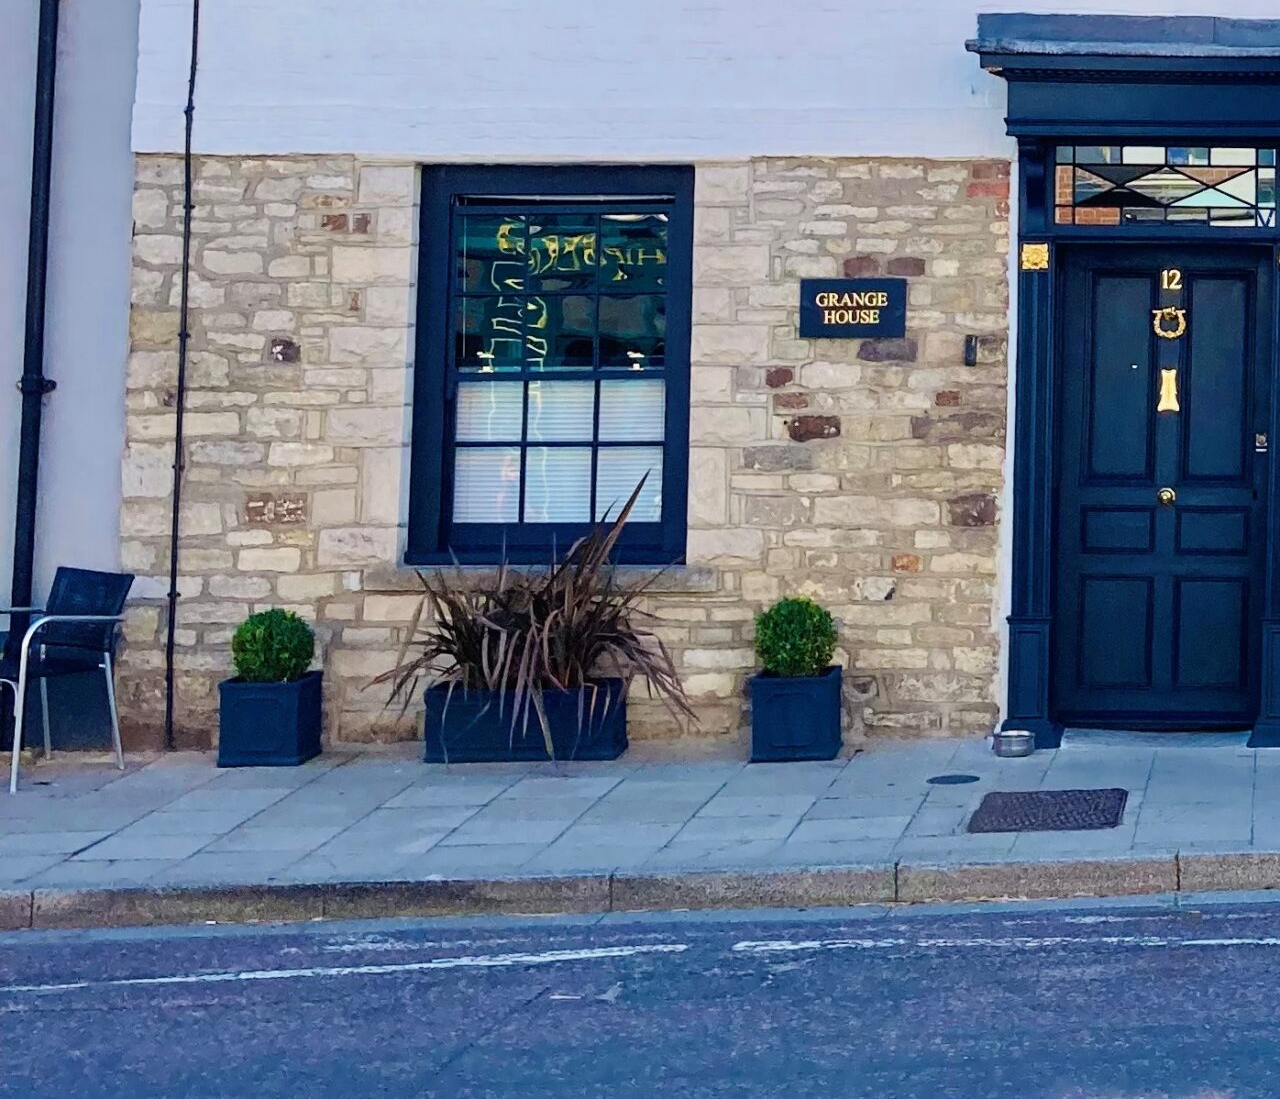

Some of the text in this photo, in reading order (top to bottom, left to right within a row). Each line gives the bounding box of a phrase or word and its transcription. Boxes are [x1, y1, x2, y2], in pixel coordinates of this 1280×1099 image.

[1161, 269, 1183, 290] 12
[815, 292, 889, 307] GRANGE
[823, 309, 881, 324] HOUSE
